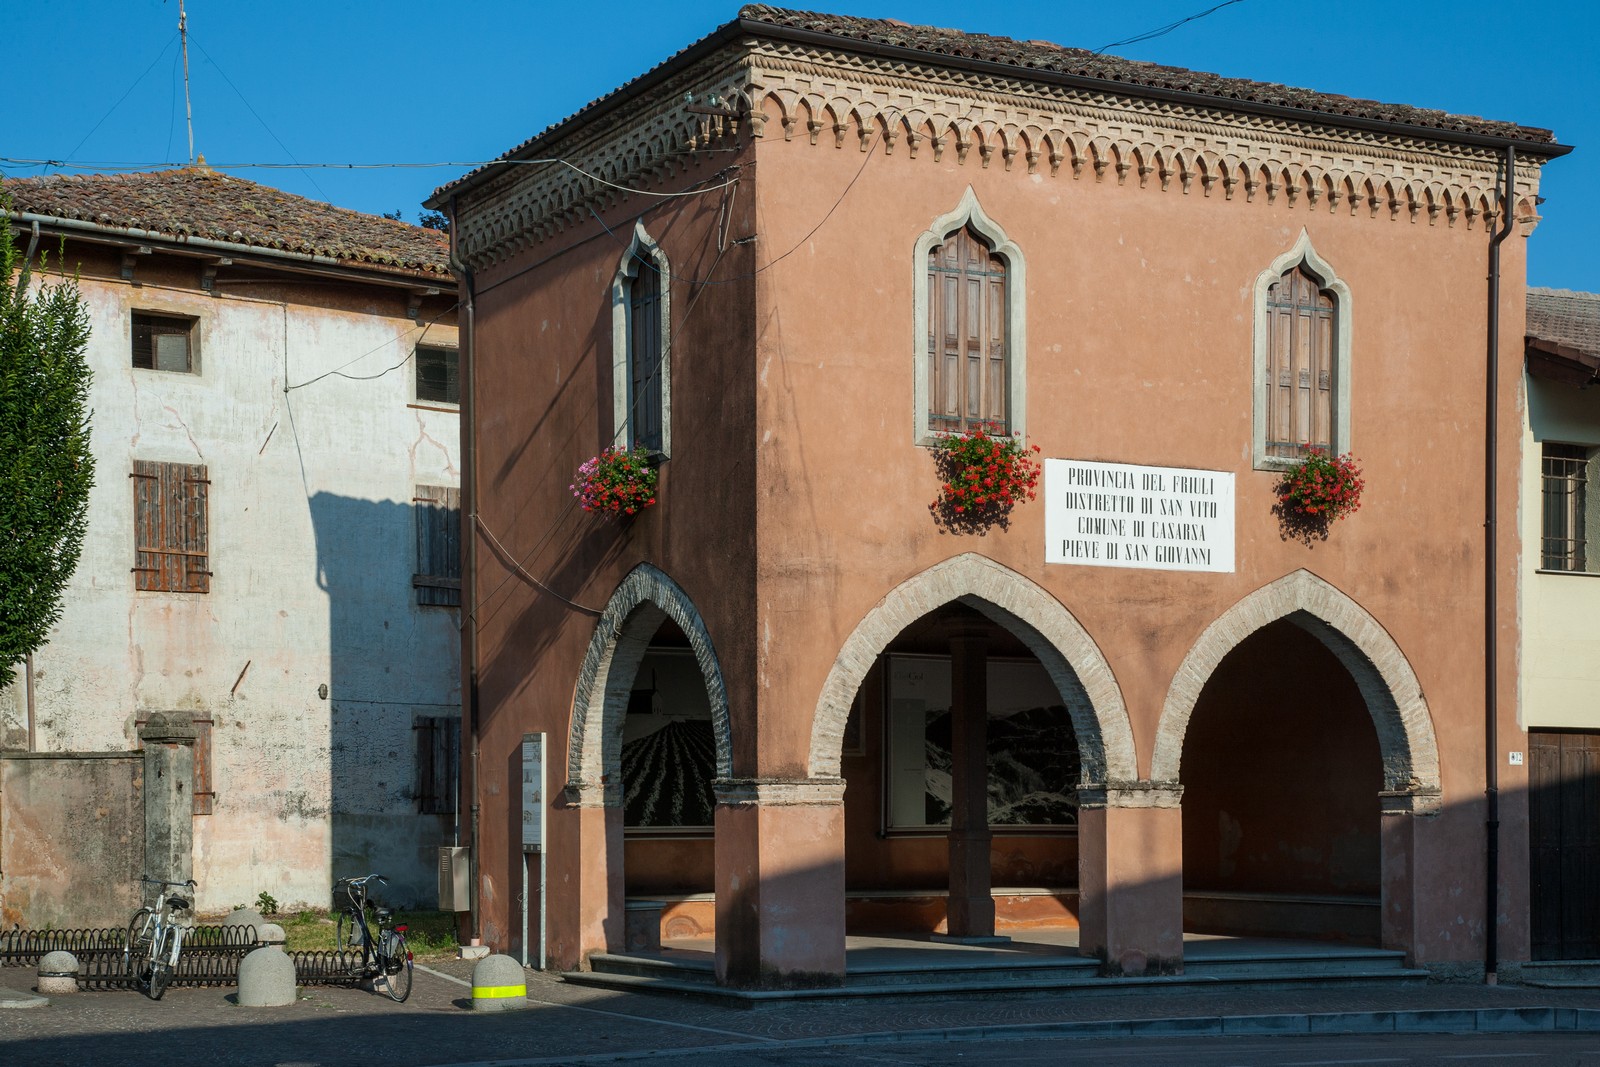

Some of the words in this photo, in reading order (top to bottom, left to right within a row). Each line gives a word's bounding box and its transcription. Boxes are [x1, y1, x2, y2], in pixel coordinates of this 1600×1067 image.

[1069, 468, 1135, 490] PROVINCIA
[1143, 473, 1166, 492] DEL
[1174, 476, 1214, 495] FRIULI
[1066, 491, 1134, 513] DISTRETTO
[1142, 497, 1153, 514] DI
[1161, 498, 1183, 516] SAN
[1190, 501, 1217, 518] VITO
[1078, 516, 1126, 537] COMUNE
[1133, 521, 1145, 538] DI
[1152, 522, 1206, 541] CASARSA
[1062, 540, 1100, 559] PIEVE
[1107, 543, 1118, 560] DI
[1126, 544, 1149, 561] SAN
[1156, 546, 1211, 565] GIOVANNI
